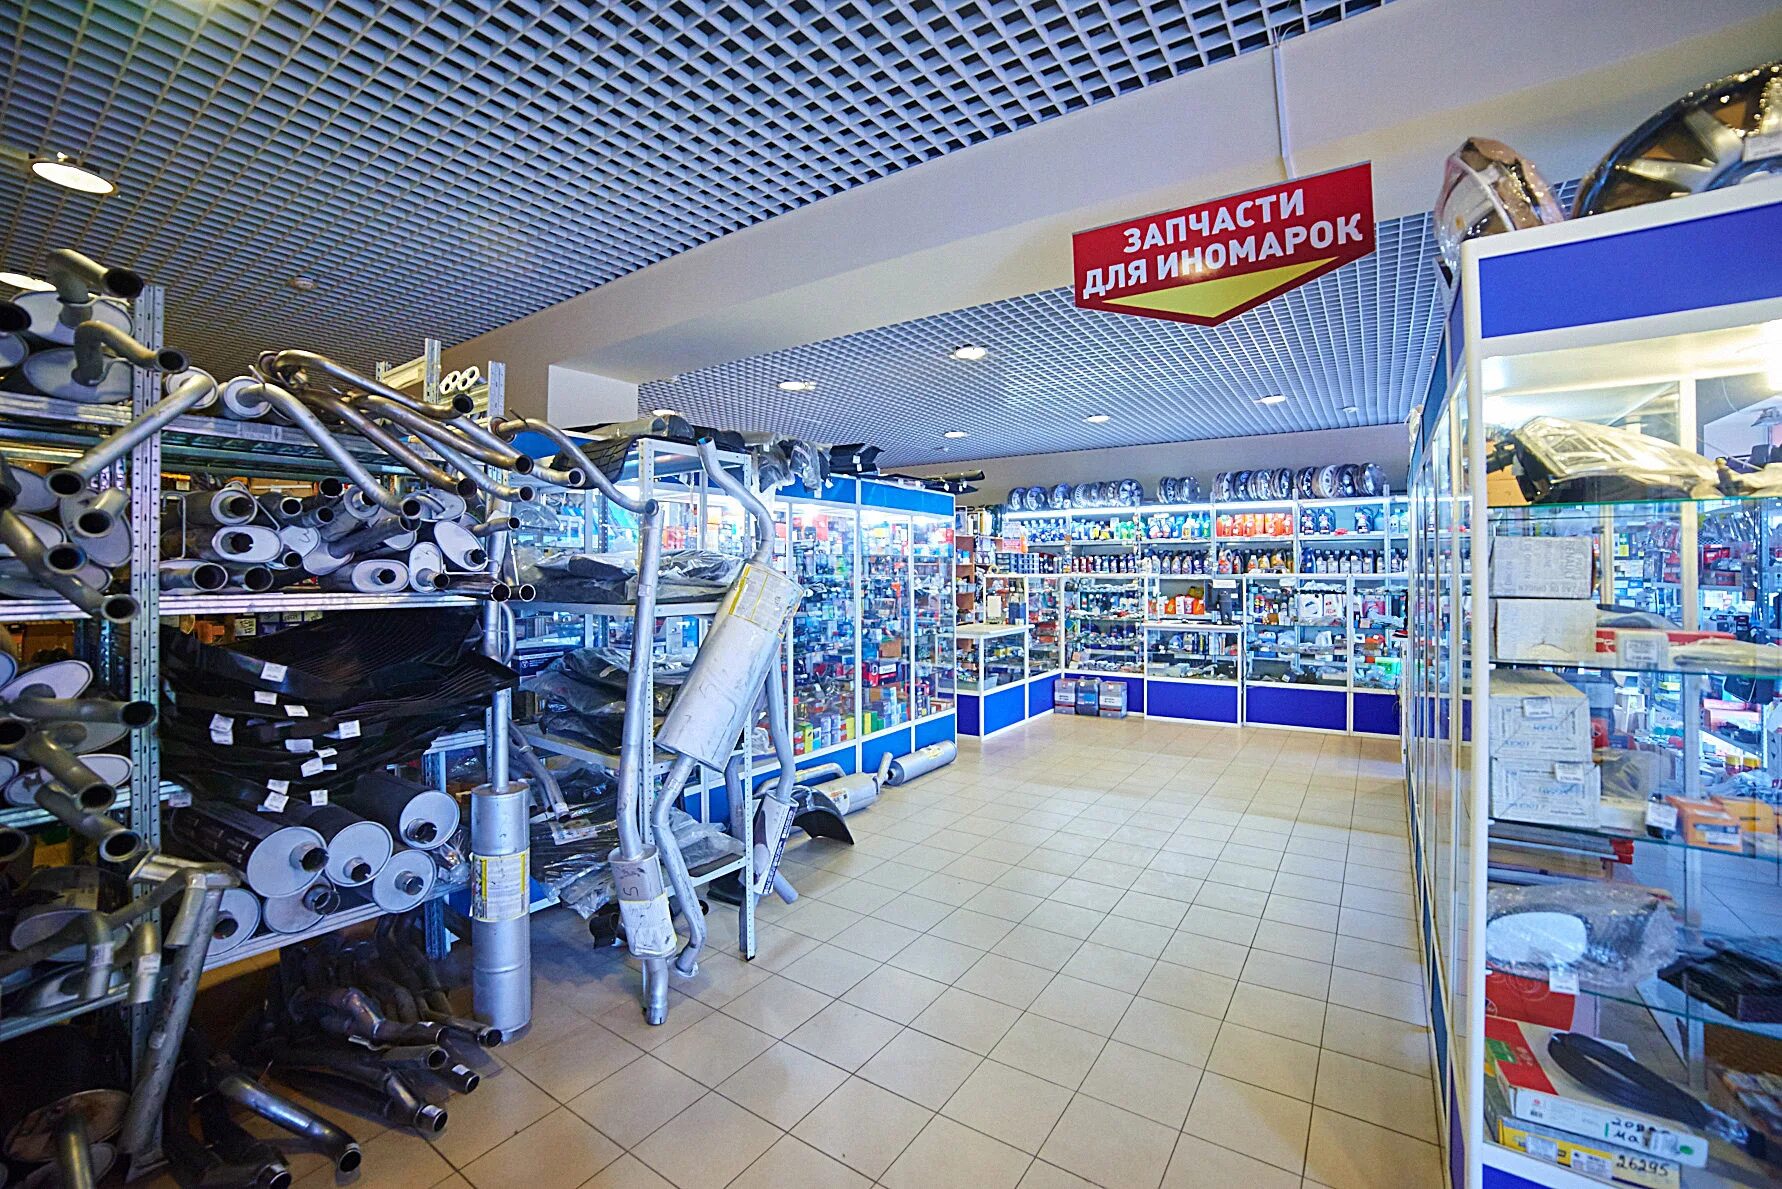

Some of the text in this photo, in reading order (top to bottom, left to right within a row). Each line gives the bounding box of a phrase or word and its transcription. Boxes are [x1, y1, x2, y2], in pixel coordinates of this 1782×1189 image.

[1123, 188, 1304, 254] ЗАПЧАСТИ
[1083, 213, 1363, 300] ДЛЯ ИНОМАРОК
[1616, 1154, 1668, 1177] 26295
